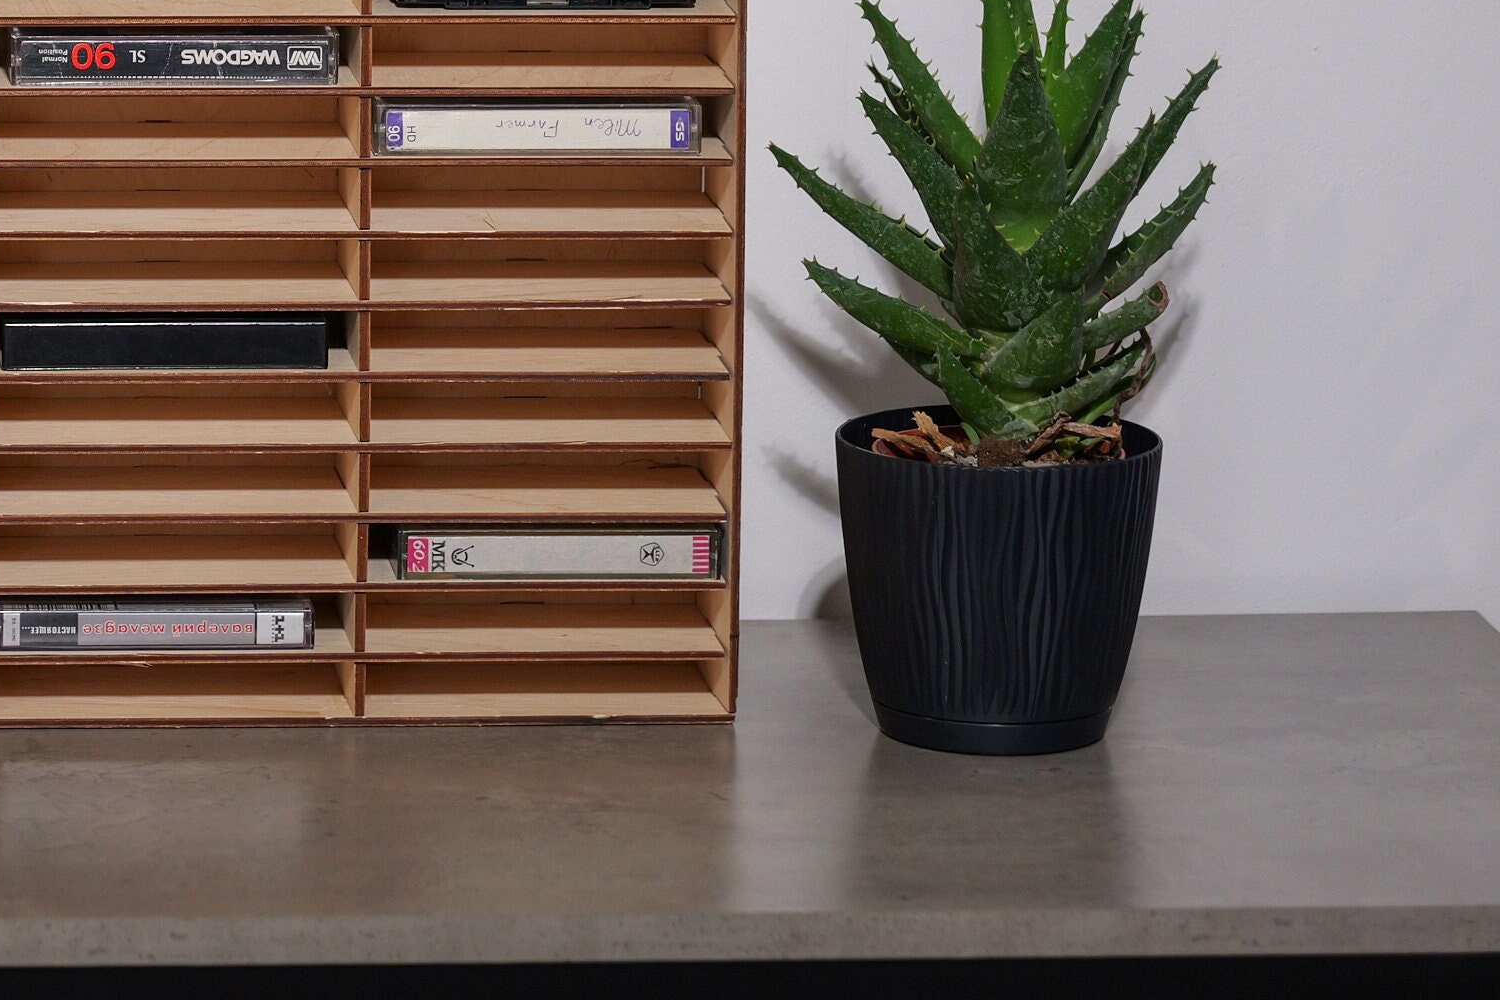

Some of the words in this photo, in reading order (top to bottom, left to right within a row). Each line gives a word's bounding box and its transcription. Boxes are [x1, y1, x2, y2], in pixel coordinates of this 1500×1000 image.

[38, 48, 68, 56] Position
[71, 42, 117, 70] 90
[129, 49, 146, 63] SL
[181, 49, 280, 65] WAGDOMS
[387, 125, 400, 142] 90
[406, 125, 416, 142] HD
[584, 116, 642, 136] Milen
[675, 121, 685, 142] GS
[21, 624, 76, 635] НАСТОЯЩЕЕ...
[82, 622, 165, 635] меладзе
[172, 622, 253, 638] валерий
[274, 615, 286, 643] 1+1
